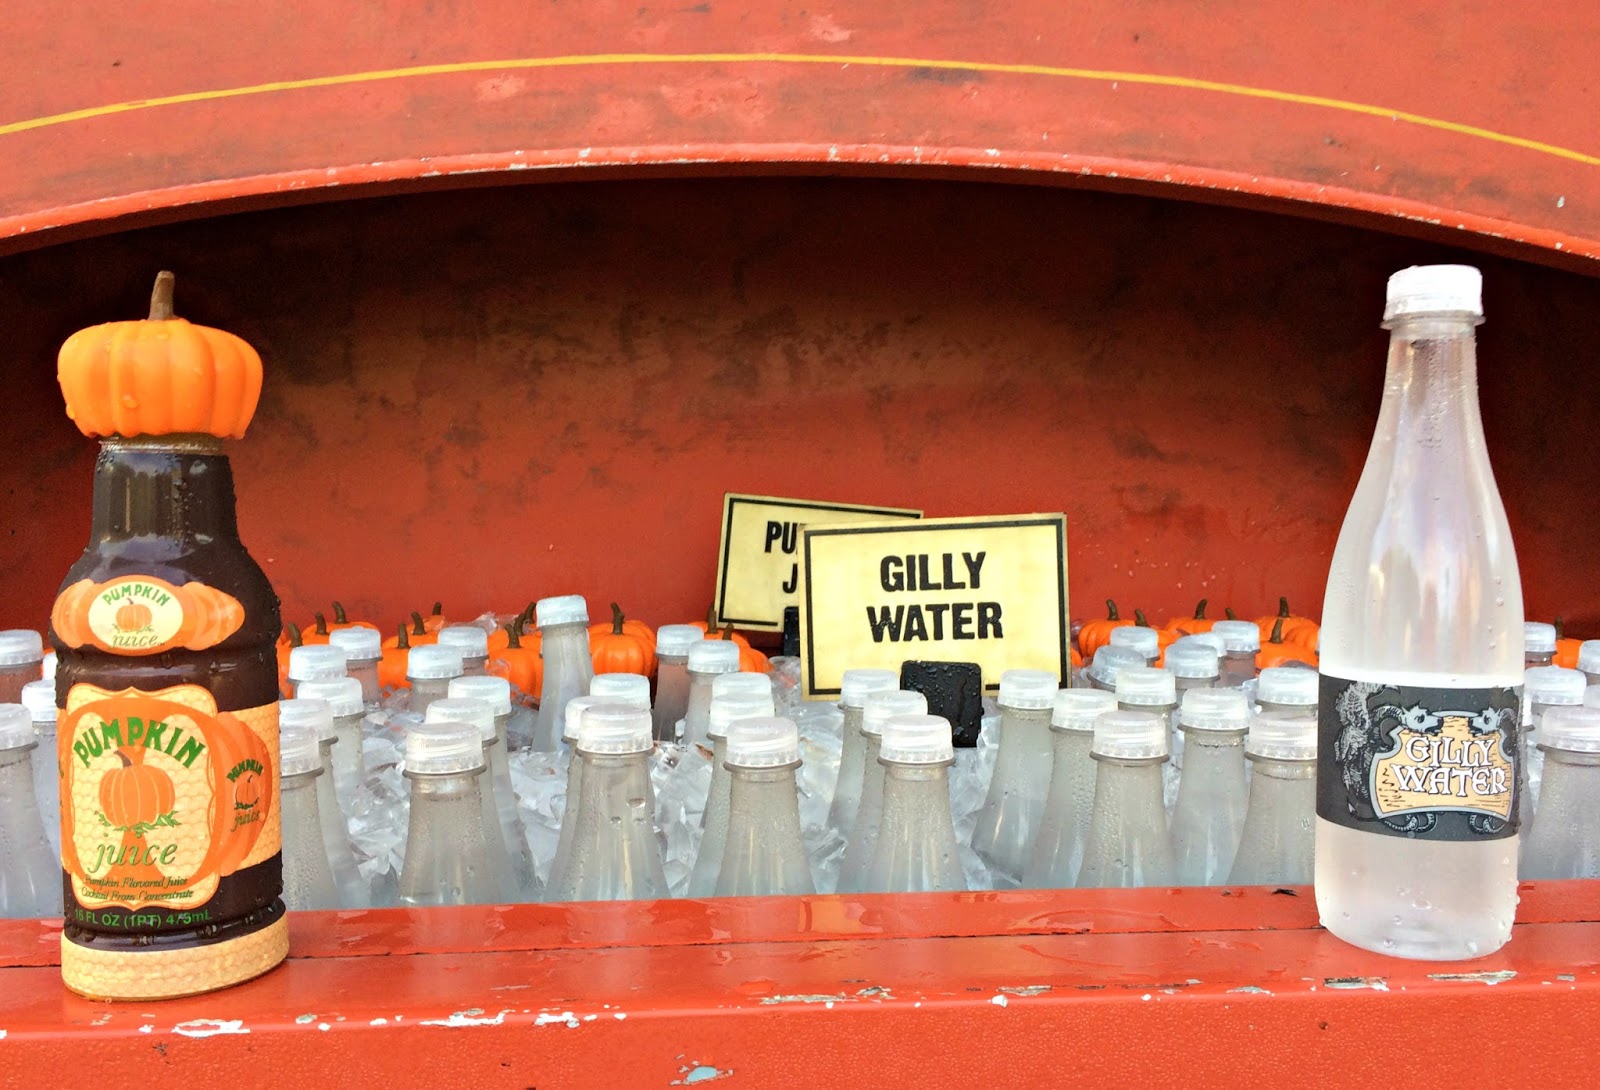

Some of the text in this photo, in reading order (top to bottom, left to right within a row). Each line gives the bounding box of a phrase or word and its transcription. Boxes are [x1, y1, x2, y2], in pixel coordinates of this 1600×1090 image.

[765, 521, 798, 555] PU
[782, 563, 798, 593] J
[880, 551, 986, 592] GILLY
[102, 584, 171, 606] PUMPKIN
[866, 602, 1004, 643] WATER
[112, 634, 159, 649] juice
[73, 716, 206, 769] PUMPKIN
[1405, 736, 1495, 768] GILLY
[1389, 763, 1508, 798] WATER
[87, 834, 178, 873] juice
[81, 886, 194, 901] Cocktail From Concentrate
[85, 874, 188, 889] Pumpkin Flavored Juice
[75, 908, 84, 921] 16
[86, 911, 98, 924] FL
[102, 913, 120, 926] OZ
